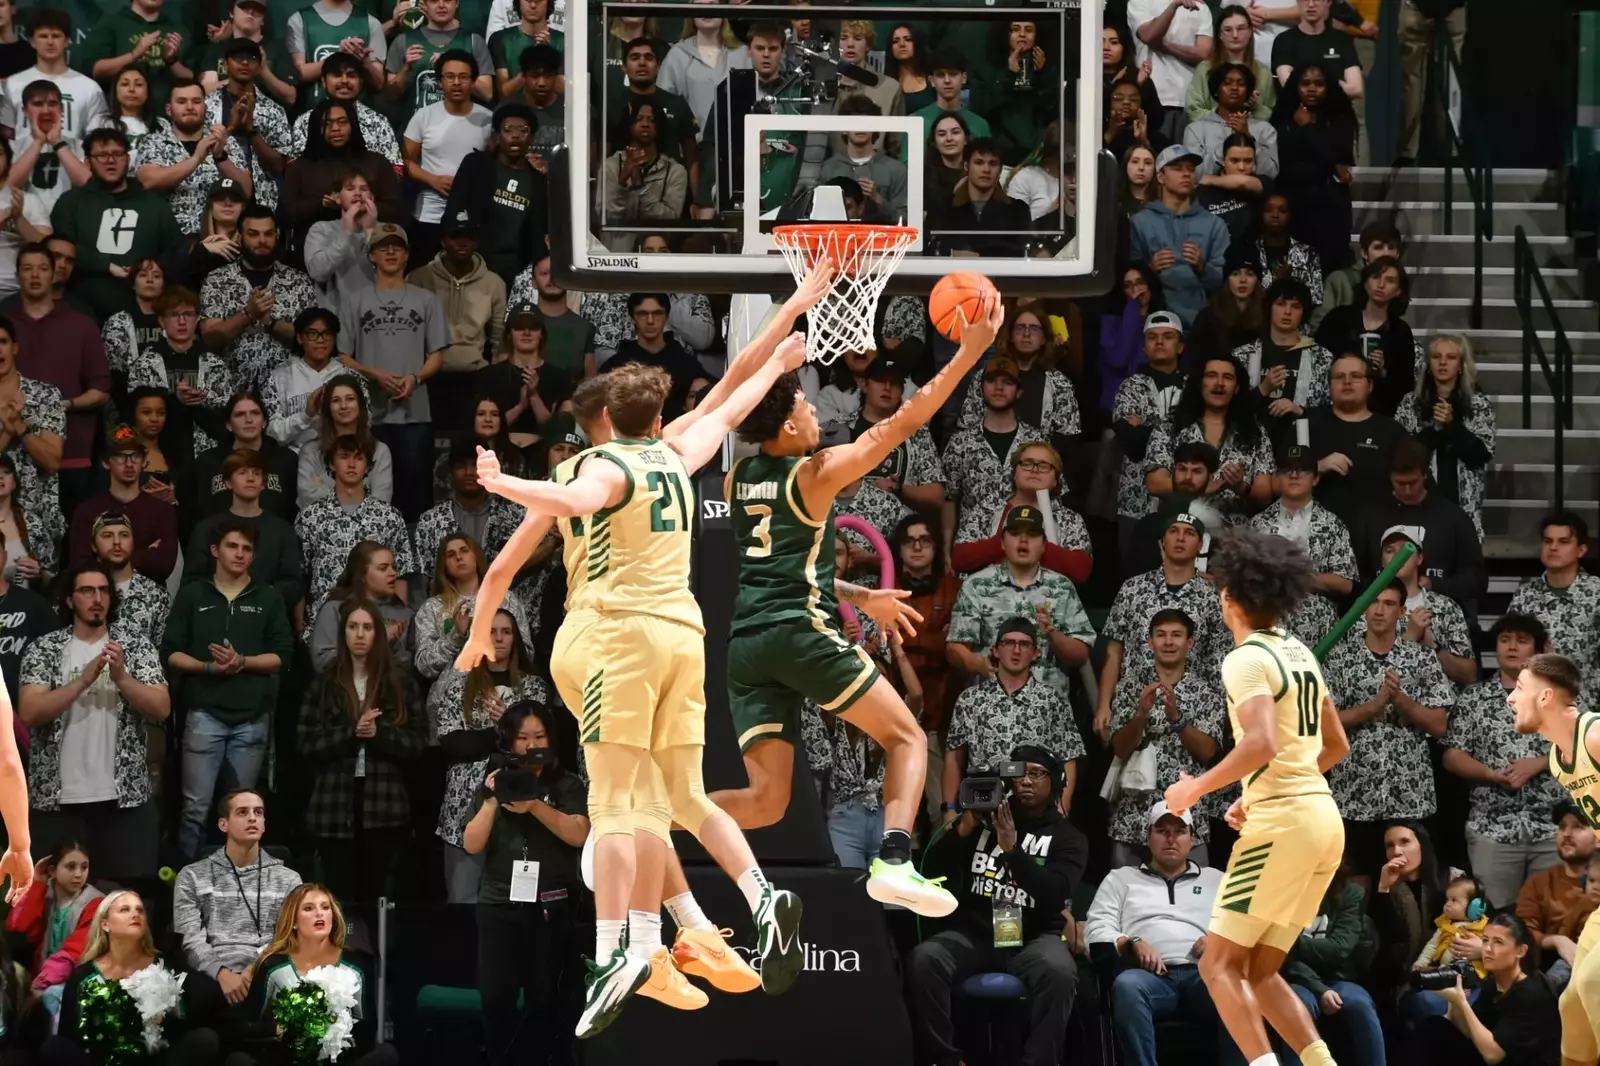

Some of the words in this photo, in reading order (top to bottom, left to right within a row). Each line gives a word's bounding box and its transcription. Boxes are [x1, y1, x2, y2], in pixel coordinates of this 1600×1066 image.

[587, 256, 638, 269] SPALDING
[565, 433, 582, 445] CLT
[645, 471, 688, 532] 21
[703, 500, 731, 519] SP
[1176, 513, 1197, 525] CLT
[743, 504, 773, 557] 3
[1291, 671, 1319, 736] 10
